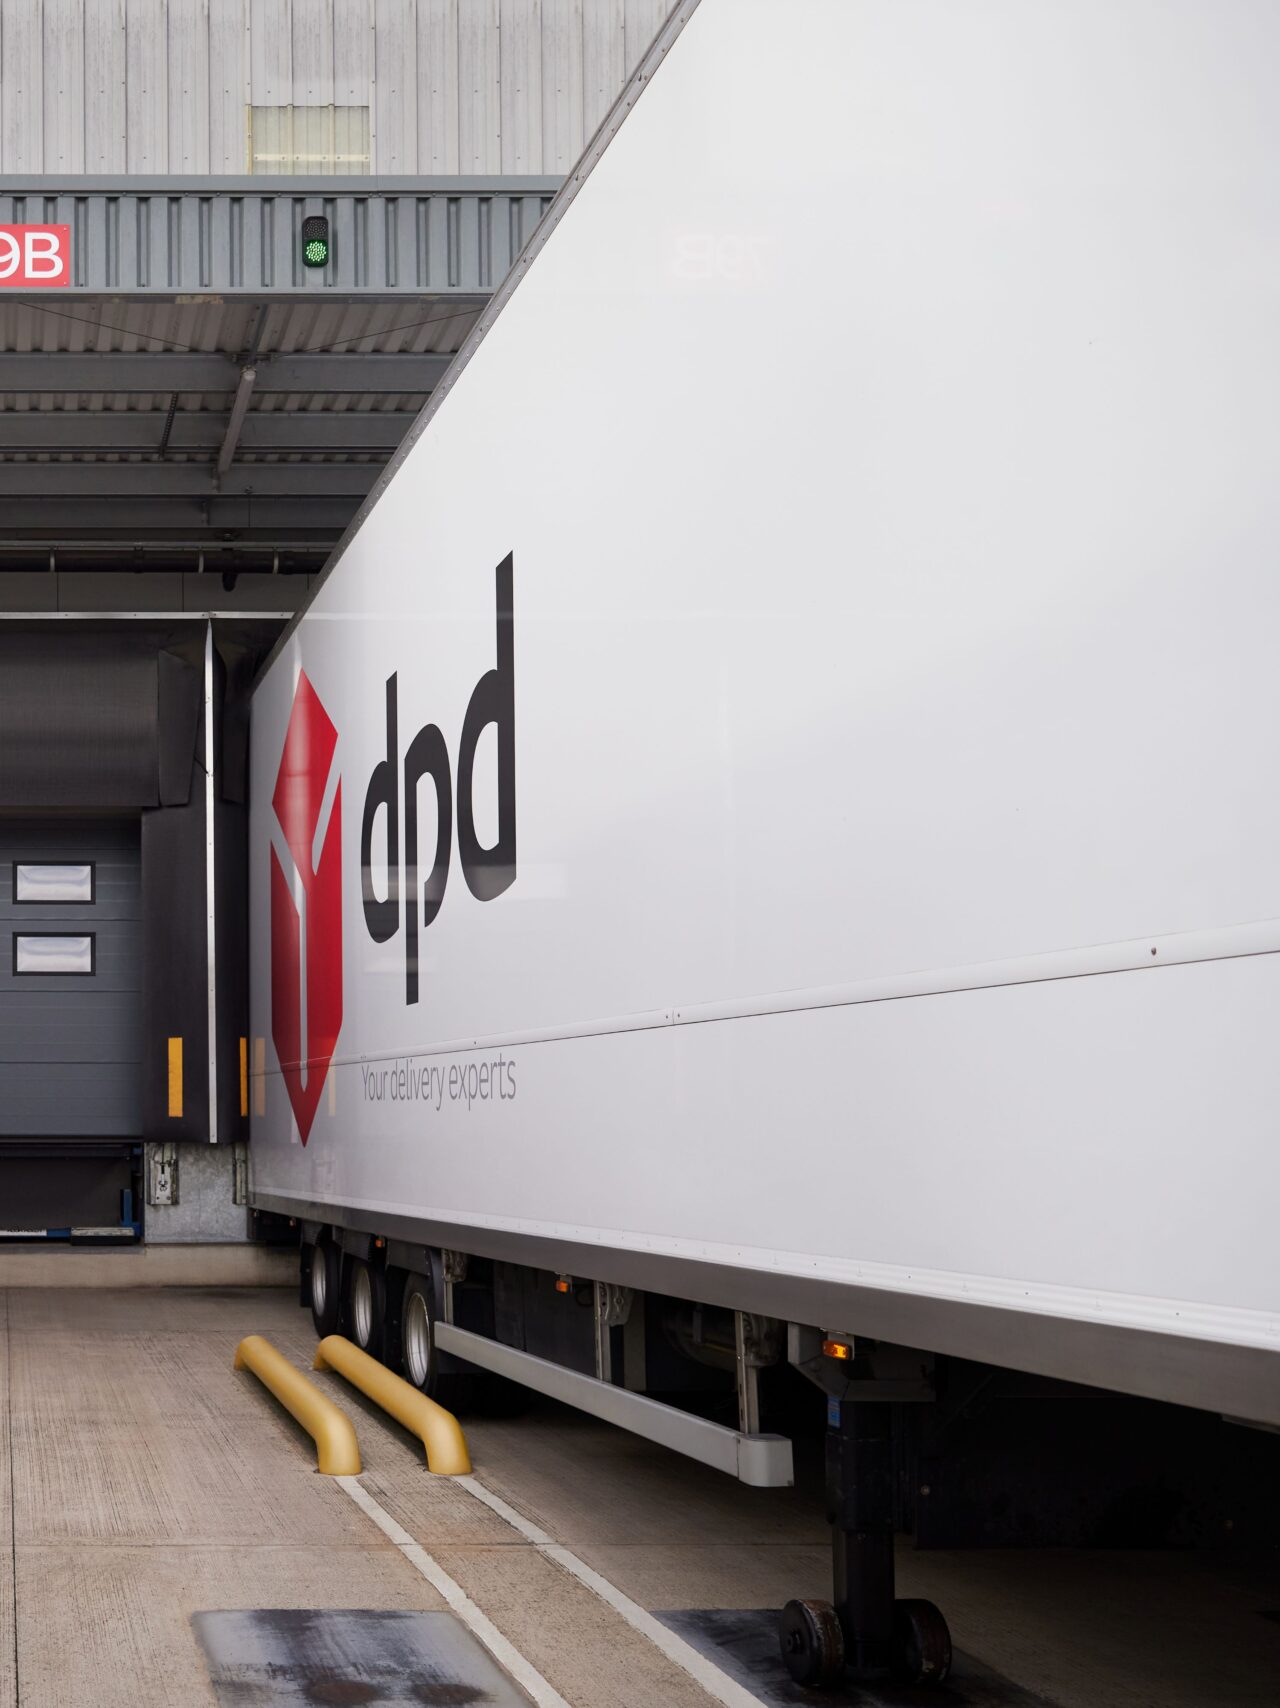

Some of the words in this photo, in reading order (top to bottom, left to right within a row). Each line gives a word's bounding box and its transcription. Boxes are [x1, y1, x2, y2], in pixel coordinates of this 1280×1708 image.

[361, 550, 516, 1005] dpd
[362, 1064, 388, 1101] Your
[390, 1058, 445, 1111] delivery
[448, 1052, 517, 1112] experts
